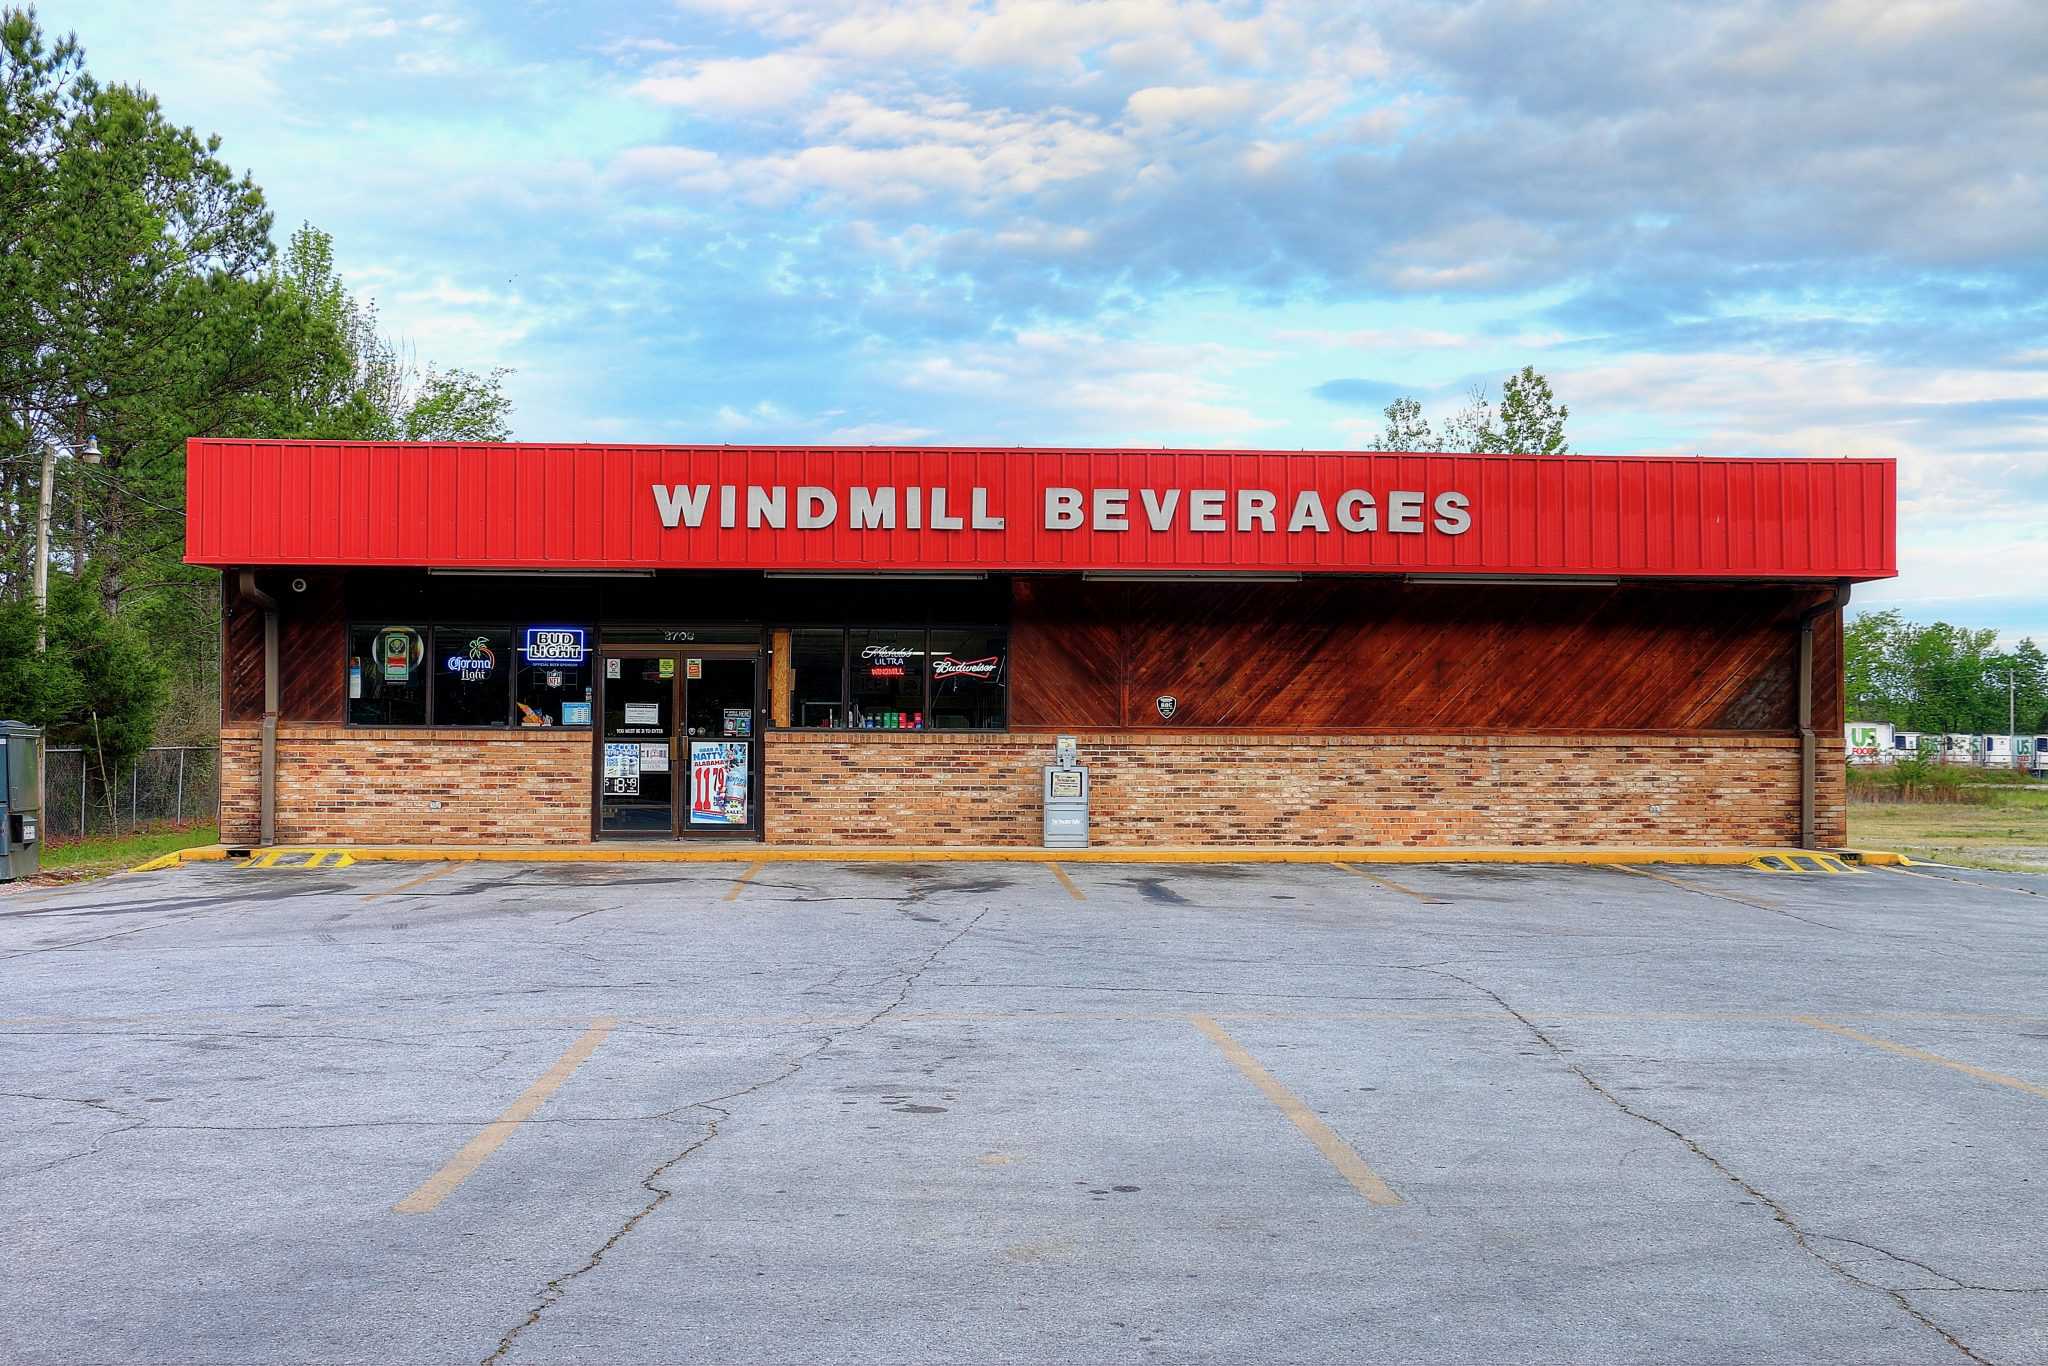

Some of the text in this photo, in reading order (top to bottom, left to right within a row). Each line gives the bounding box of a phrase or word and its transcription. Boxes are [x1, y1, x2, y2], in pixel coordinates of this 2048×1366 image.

[652, 484, 1473, 536] WINDMILL BEVERAGES
[537, 632, 574, 646] BUD
[530, 644, 581, 658] LIGHT
[448, 656, 491, 672] Corona
[874, 657, 904, 666] ULTRA
[932, 660, 997, 675] Budweiser
[460, 668, 486, 682] Light
[693, 751, 724, 761] NATTY
[694, 767, 711, 812] 11
